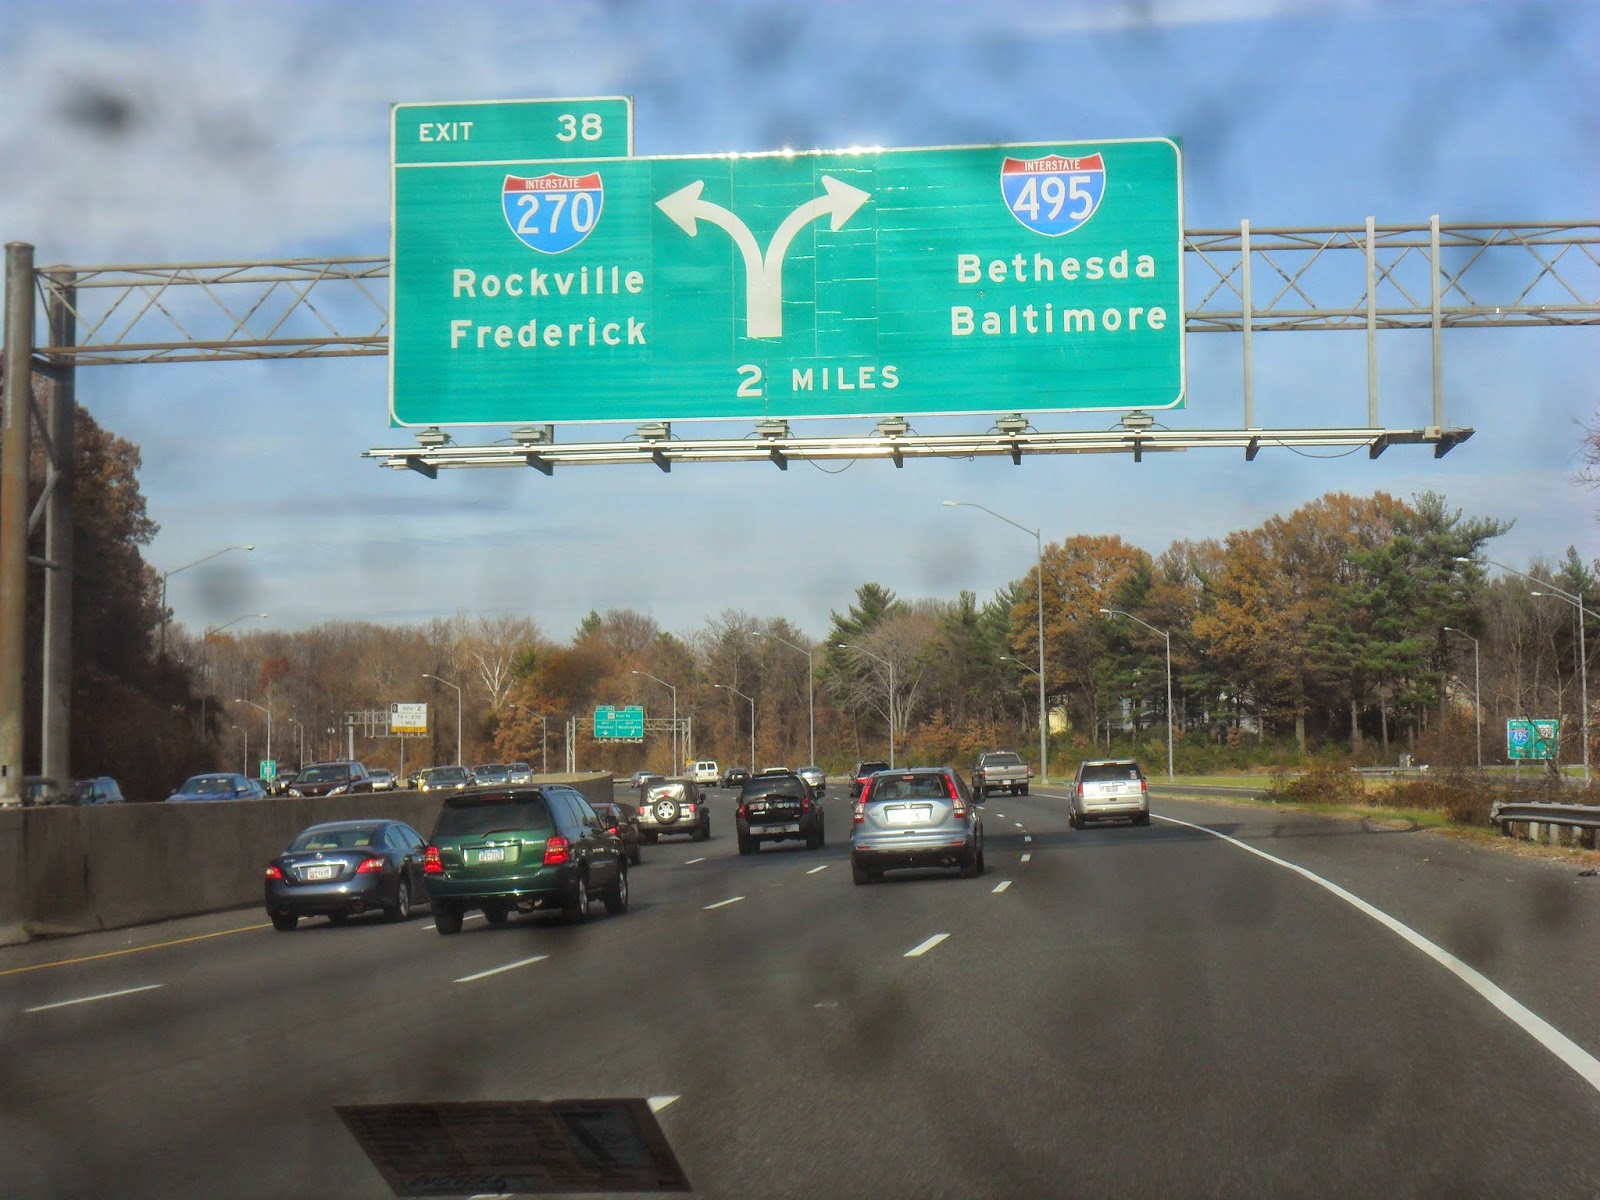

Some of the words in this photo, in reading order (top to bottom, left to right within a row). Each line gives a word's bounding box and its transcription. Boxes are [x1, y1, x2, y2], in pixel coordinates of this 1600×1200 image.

[419, 121, 473, 142] EXIT
[556, 113, 603, 142] 38
[1024, 160, 1081, 172] INTERSTATE
[525, 178, 580, 190] INTERSTATE
[1012, 175, 1093, 221] 495
[517, 192, 595, 234] 270
[453, 265, 644, 298] Rockville
[957, 249, 1156, 284] Bethesda
[450, 316, 647, 349] Frederick
[951, 302, 1167, 336] Baltimore
[736, 364, 763, 398] 2
[792, 365, 899, 392] MILES
